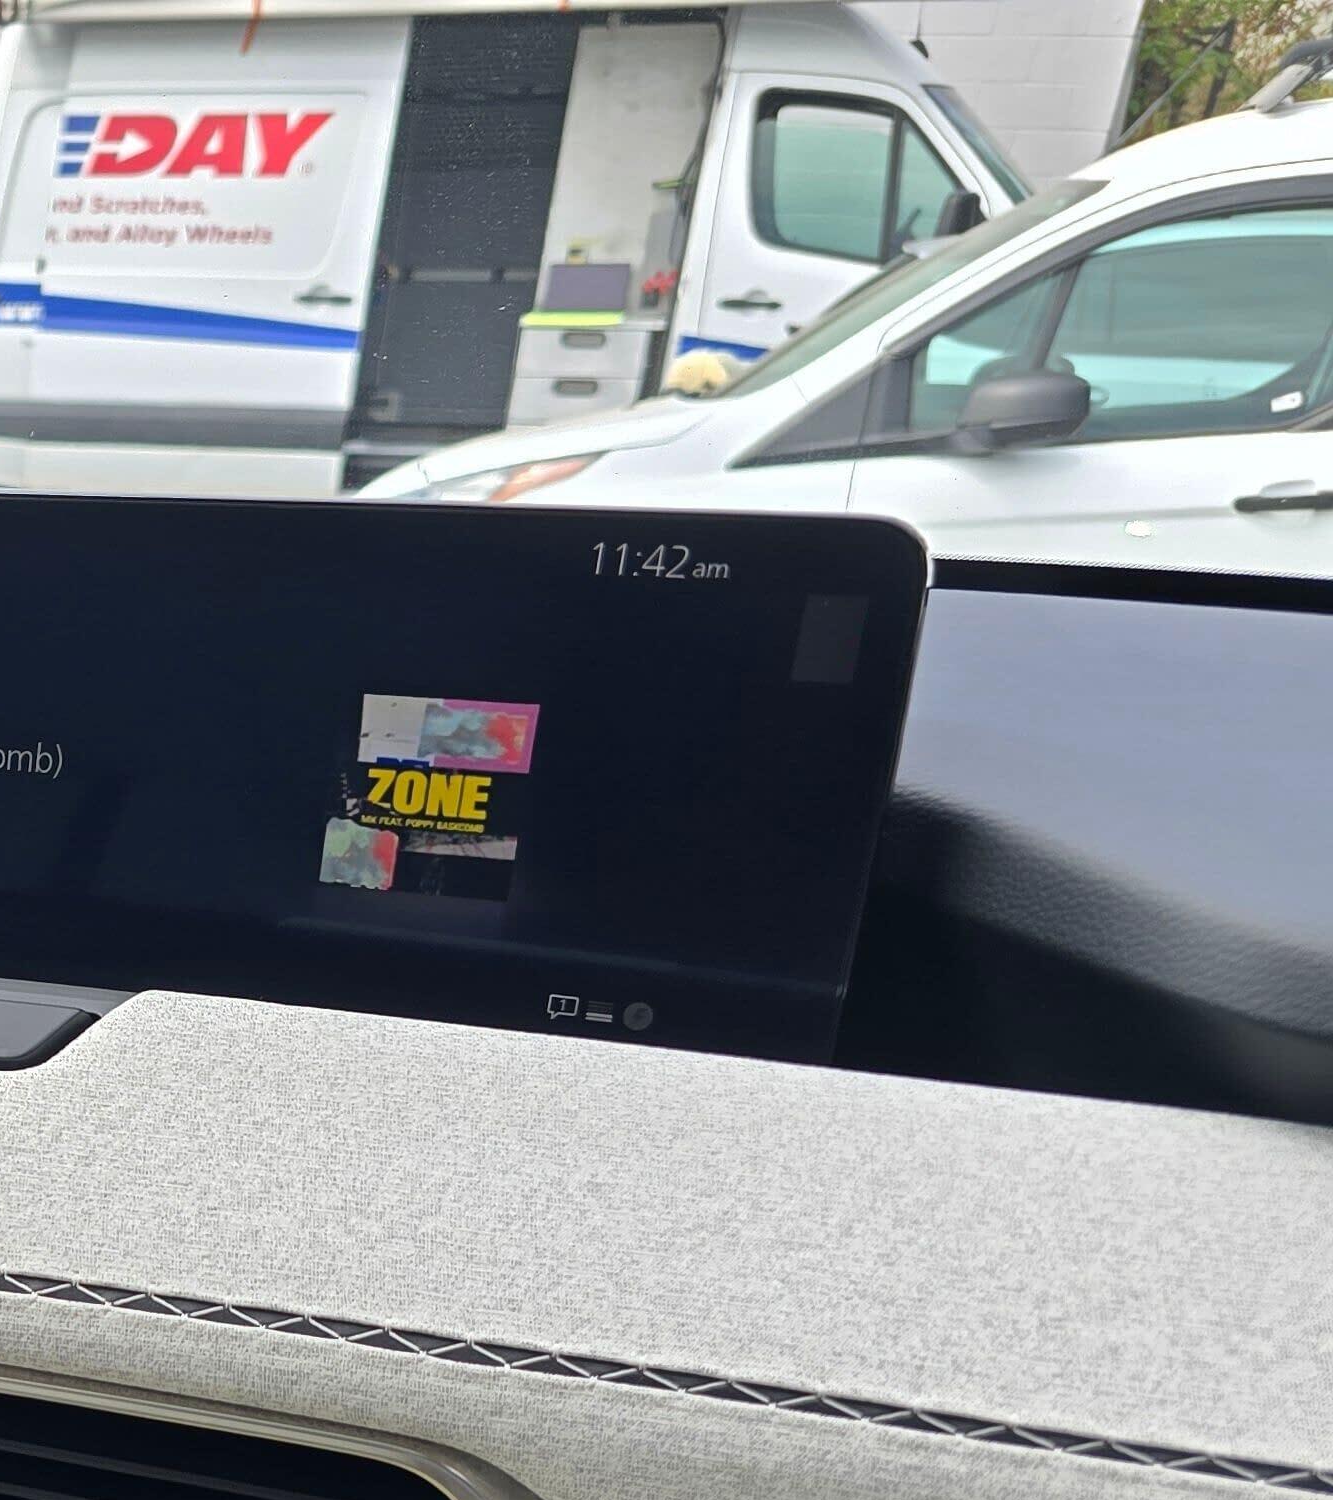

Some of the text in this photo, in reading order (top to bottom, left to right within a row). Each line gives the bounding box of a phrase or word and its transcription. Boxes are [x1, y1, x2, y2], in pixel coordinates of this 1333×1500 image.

[88, 195, 207, 217] Scratches,
[67, 224, 109, 244] and
[116, 225, 178, 248] Alloy
[186, 225, 273, 246] Wheels
[367, 768, 492, 820] ZONE
